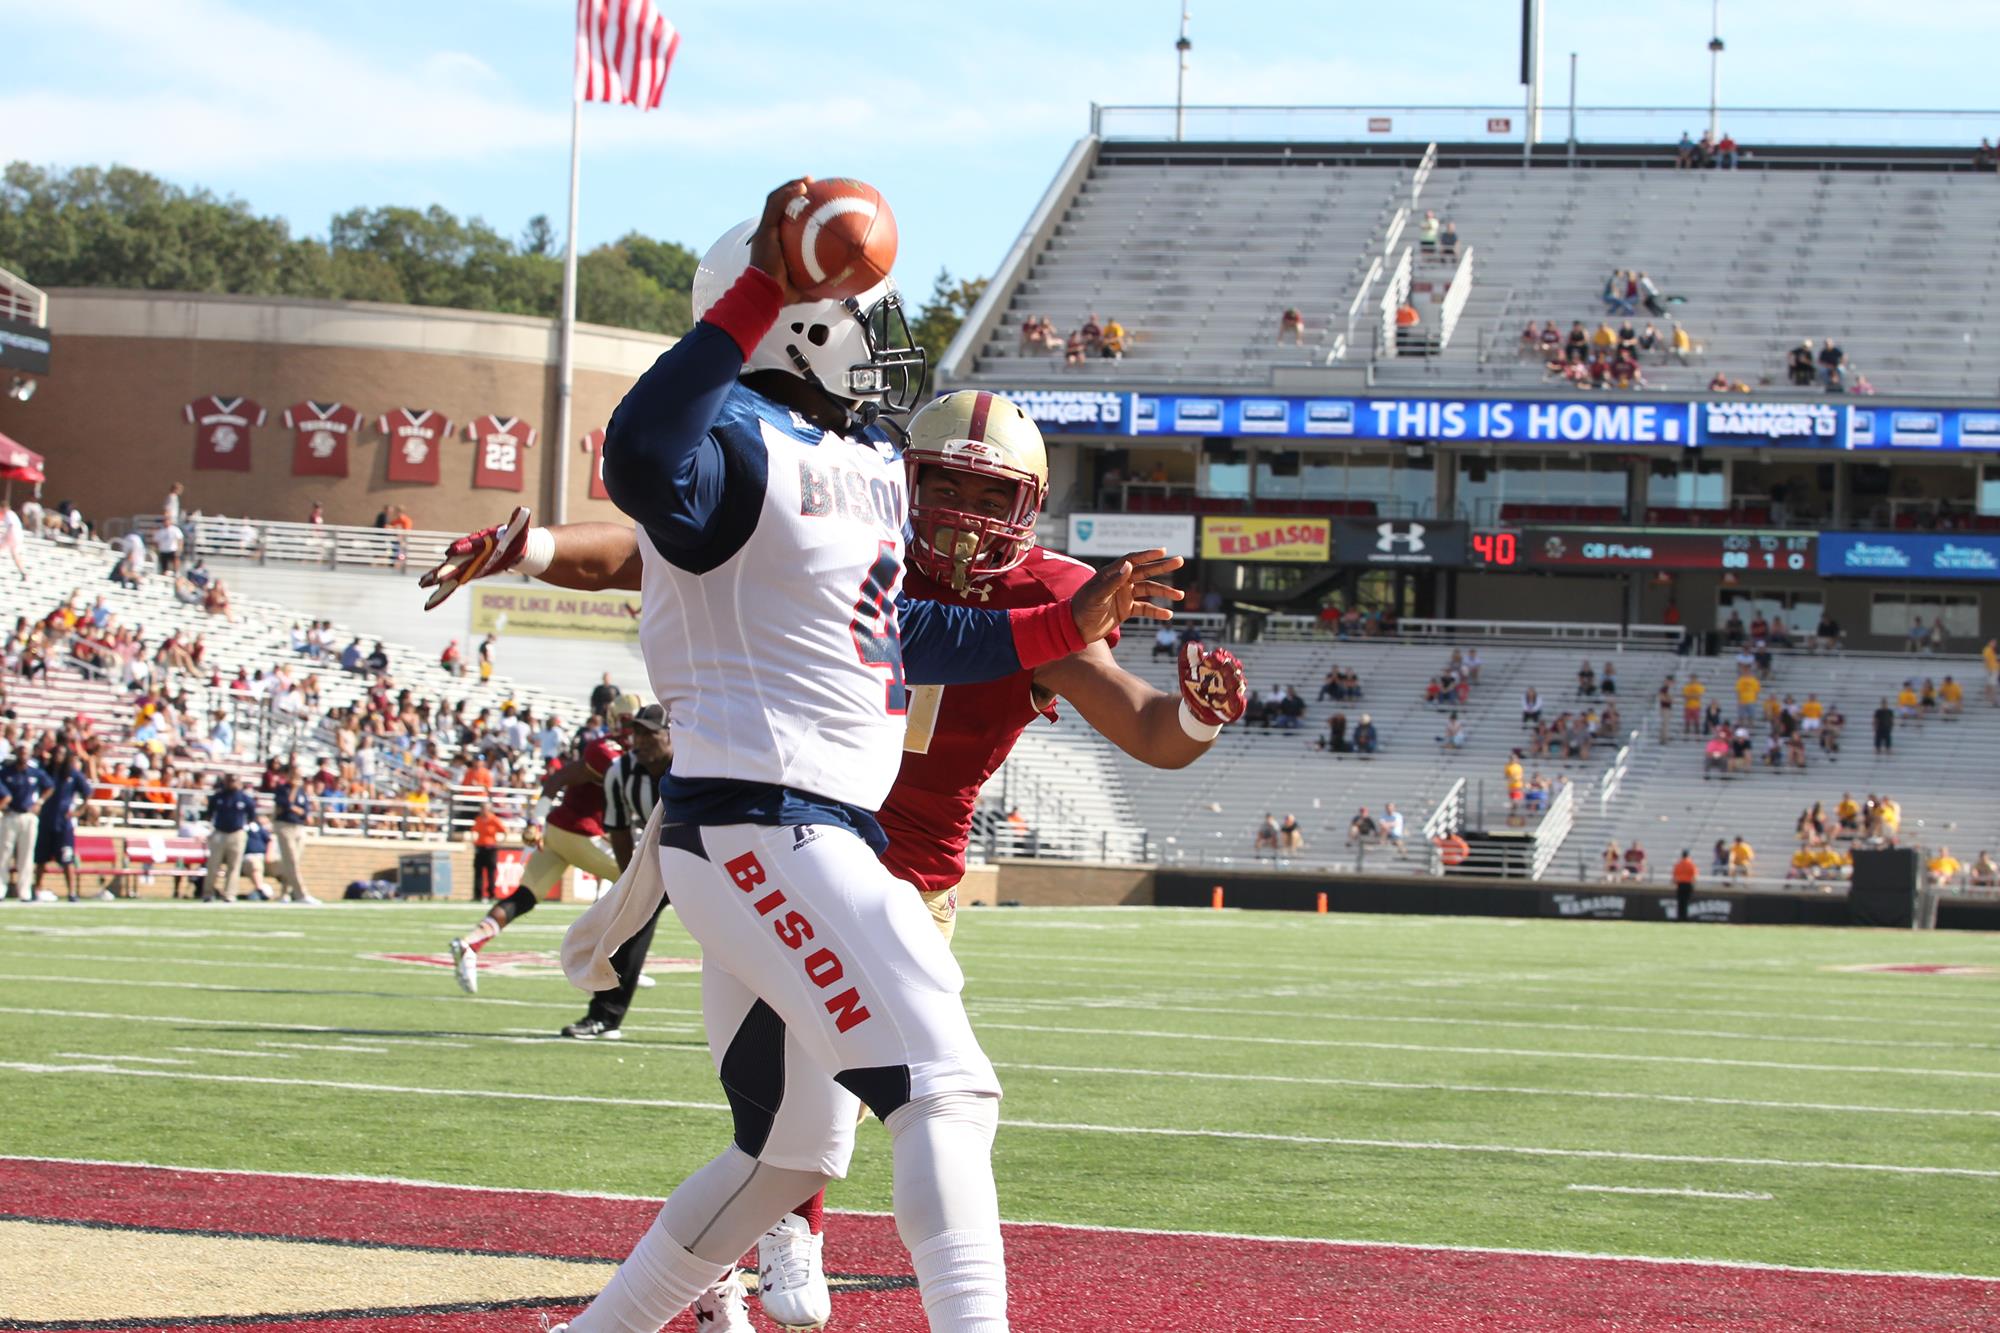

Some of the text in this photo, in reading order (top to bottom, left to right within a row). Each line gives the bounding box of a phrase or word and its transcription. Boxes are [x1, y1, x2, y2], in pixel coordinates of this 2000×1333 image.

[1370, 402, 1656, 440] THIS IS HOME
[485, 443, 516, 472] 22
[961, 443, 989, 454] ACC
[1473, 533, 1516, 566] 40
[482, 594, 515, 611] RIDE
[519, 597, 551, 613] LIKE
[555, 600, 577, 614] AN
[849, 539, 907, 714] 4
[724, 851, 871, 1034] BISON
